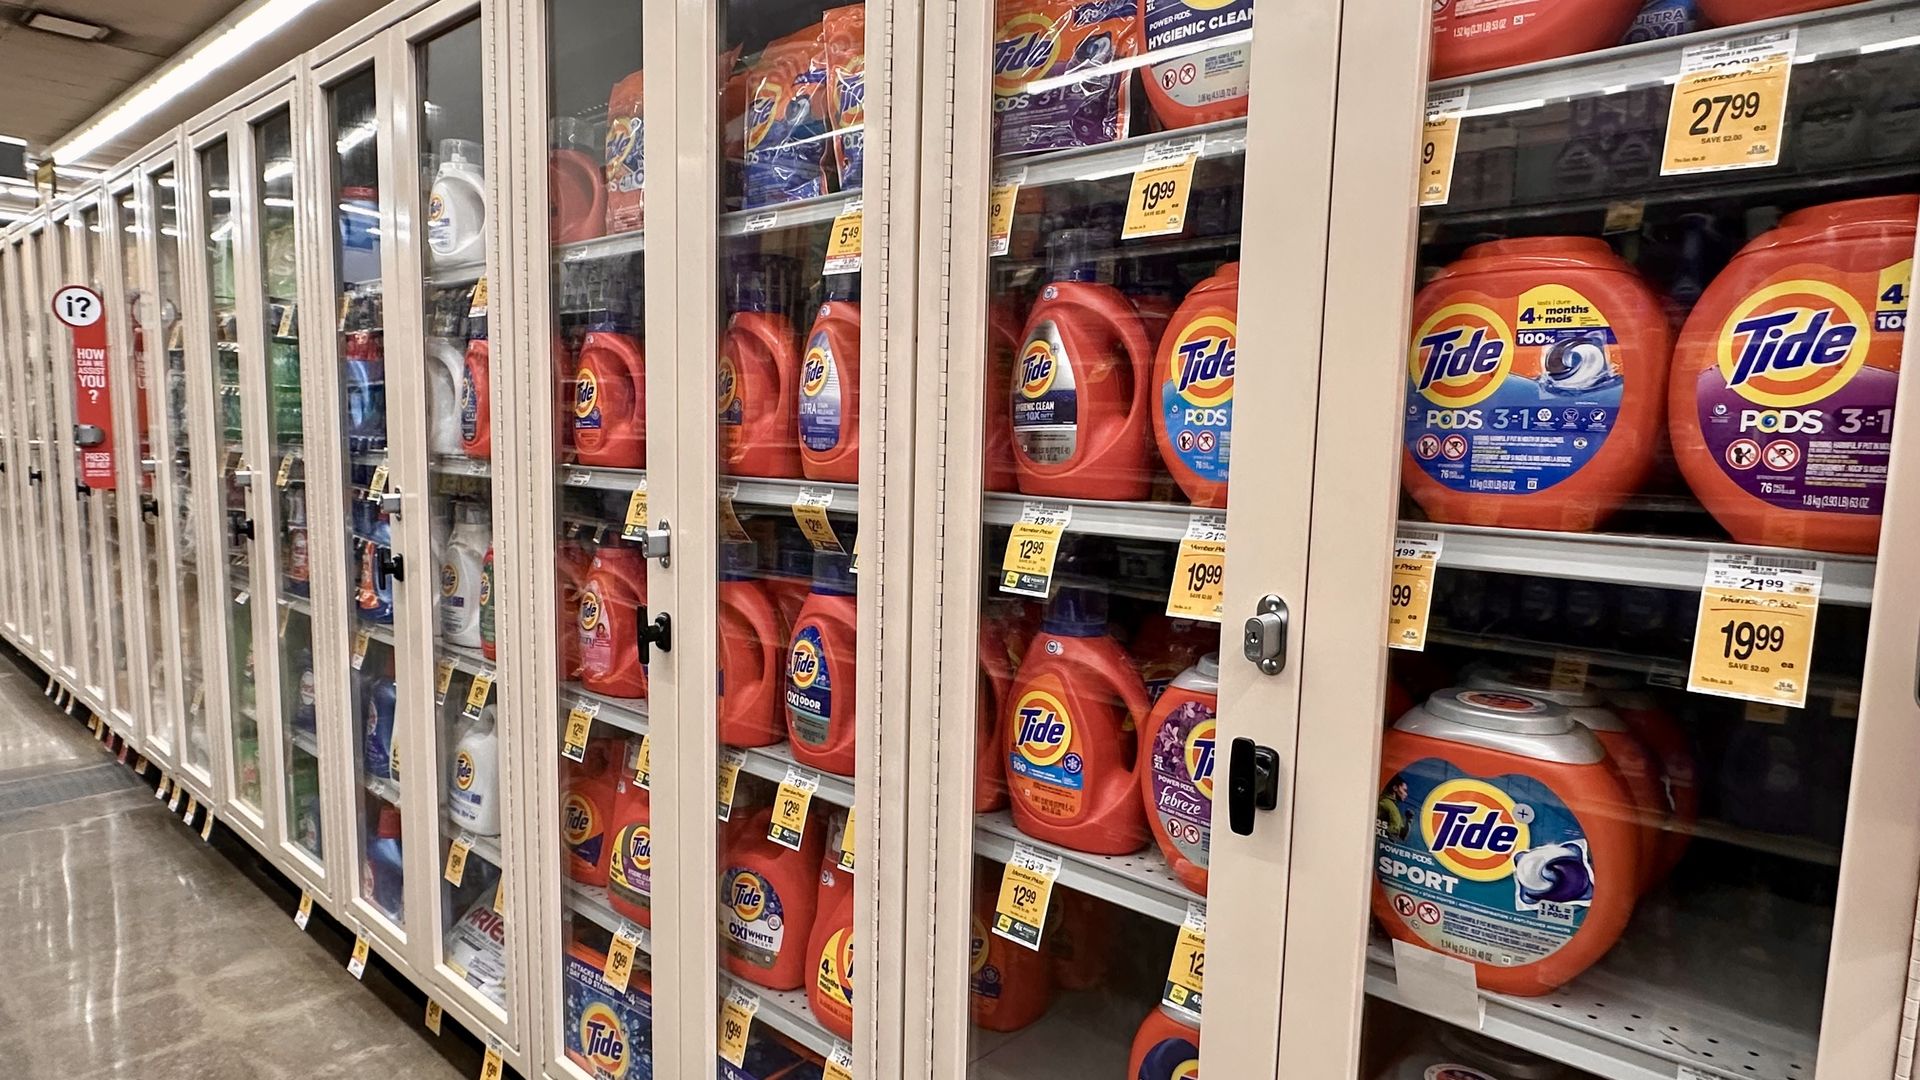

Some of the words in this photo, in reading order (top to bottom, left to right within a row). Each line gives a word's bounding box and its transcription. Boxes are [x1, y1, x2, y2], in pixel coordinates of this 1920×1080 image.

[1146, 4, 1155, 12] XL
[1148, 20, 1205, 50] HYGIENIC
[1209, 8, 1254, 30] CLEAN
[1150, 16, 1173, 31] POWER
[995, 31, 1054, 75] Tide
[995, 94, 1030, 112] ODS
[1753, 124, 1766, 132] ea
[1702, 136, 1721, 144] SAVE
[1546, 304, 1589, 316] months
[1545, 314, 1572, 324] mois
[1518, 332, 1556, 344] 100%
[77, 348, 104, 360] HOW
[1726, 308, 1858, 390] Tide
[1177, 338, 1236, 394] Tide
[1415, 326, 1504, 393] Tide
[804, 360, 824, 387] Tide
[1022, 354, 1052, 389] Tide
[79, 375, 105, 388] YOU
[88, 390, 99, 403] ?
[578, 381, 594, 403] Tide
[1036, 401, 1054, 410] CLEAN
[1026, 412, 1040, 420] 10X
[1184, 409, 1227, 426] PODS
[1426, 410, 1483, 430] PODS
[1740, 410, 1824, 434] PODS
[84, 453, 110, 462] PRESS
[1440, 470, 1449, 479] 76
[1477, 480, 1482, 490] kg
[1509, 481, 1515, 490] OZ
[1760, 482, 1772, 494] 76
[1802, 496, 1812, 505] 1.8
[1812, 496, 1821, 508] kg
[1822, 496, 1838, 508] (3.93
[1839, 497, 1849, 509] LB)
[1850, 498, 1859, 508] 63
[1859, 498, 1870, 508] OZ
[1191, 544, 1214, 552] Member
[793, 652, 815, 675] Tide
[1728, 662, 1749, 670] SAVE
[1750, 664, 1770, 673] $2.00
[787, 690, 799, 707] OXI
[800, 696, 821, 709] ODOR
[1016, 707, 1065, 747] Tide
[1154, 762, 1164, 770] XL
[1158, 775, 1180, 789] POWER
[1159, 786, 1201, 814] febreze
[565, 806, 589, 830] Tide
[1430, 802, 1518, 854] Tide
[1380, 843, 1410, 858] POWER
[1012, 869, 1031, 880] Member
[1379, 856, 1458, 894] SPORT
[734, 884, 761, 906] Tide
[1549, 904, 1561, 912] XL
[1548, 912, 1570, 920] PODS
[466, 907, 504, 945] ARIE
[729, 922, 747, 940] OXI
[748, 930, 773, 943] WHITE
[1441, 940, 1451, 949] 1.14
[1452, 942, 1458, 952] kg
[1459, 944, 1469, 956] (2.5
[570, 961, 594, 978] ATTACKS
[569, 970, 580, 979] DAY
[581, 975, 592, 985] OLD
[820, 974, 839, 990] months
[819, 981, 832, 993] mois
[587, 1021, 623, 1060] Tide
